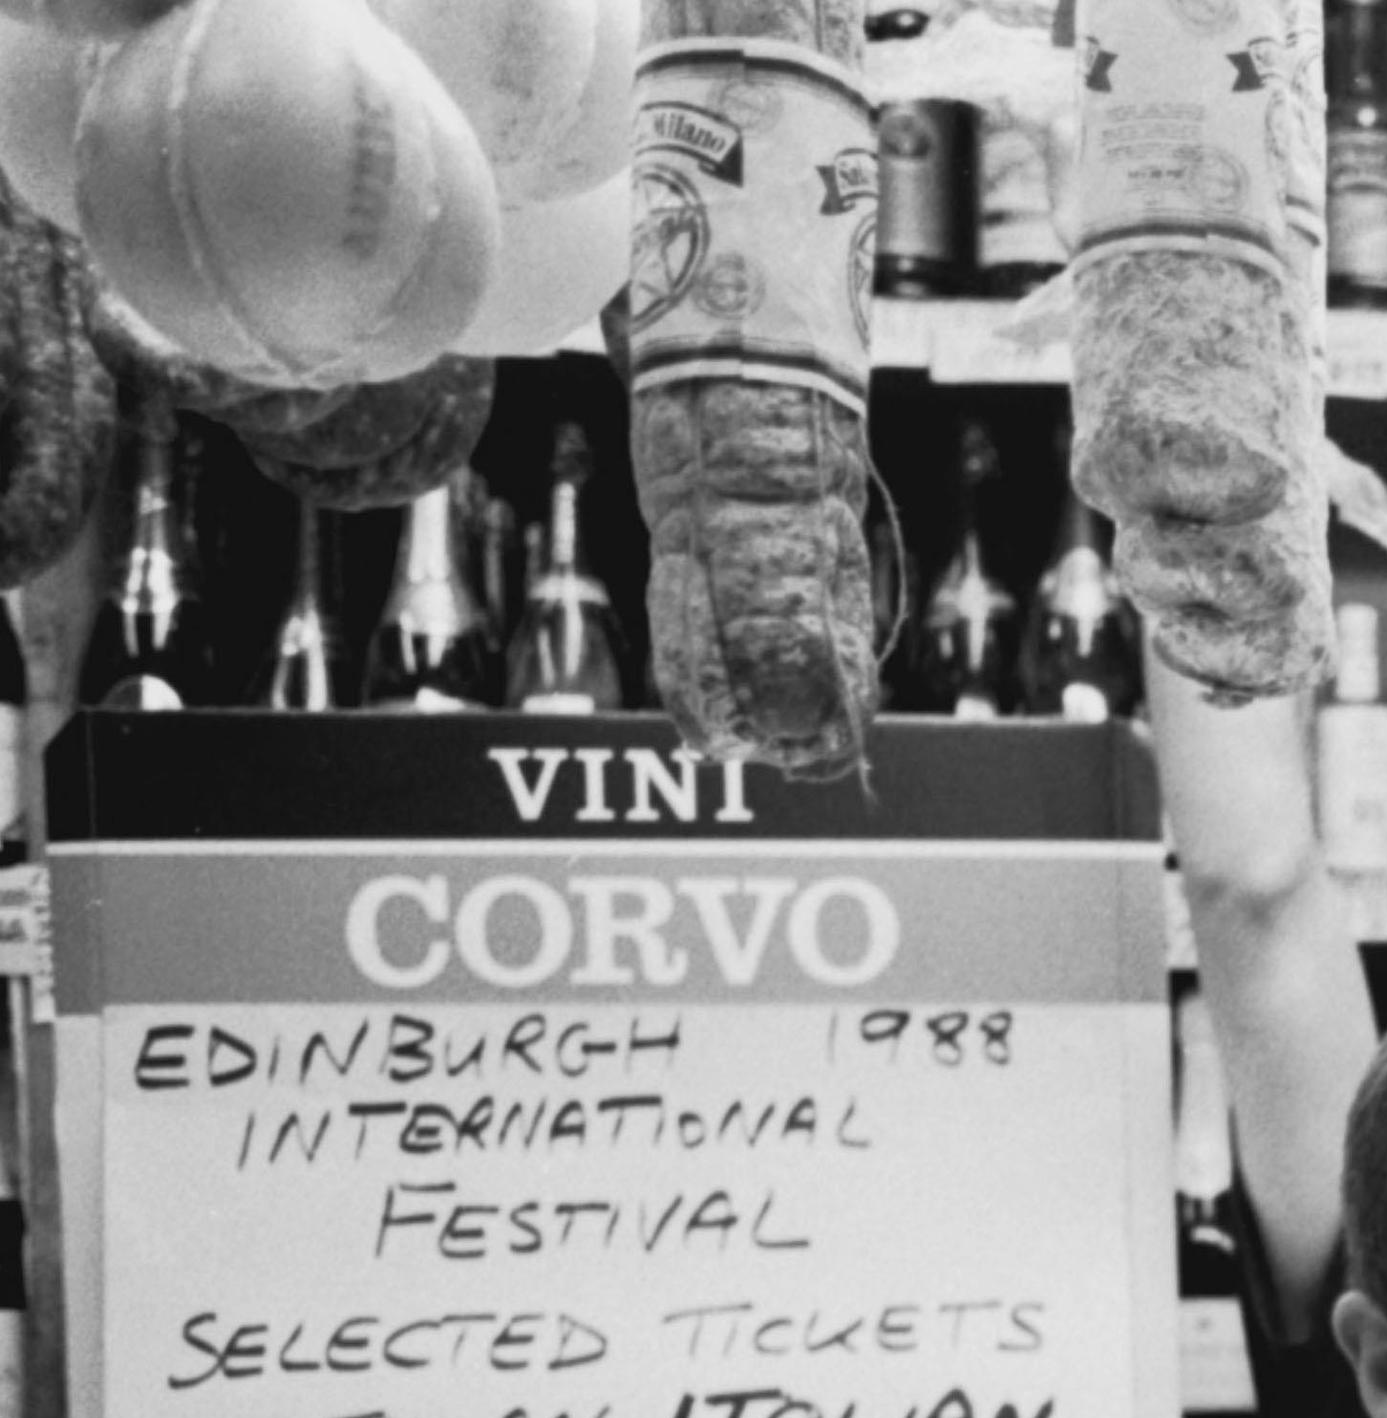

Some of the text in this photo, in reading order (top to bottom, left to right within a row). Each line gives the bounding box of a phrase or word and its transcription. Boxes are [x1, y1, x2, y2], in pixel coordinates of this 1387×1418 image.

[488, 748, 754, 823] VINI
[345, 875, 900, 988] CORVO
[131, 1008, 1016, 1090] EDINBURGH 1988
[236, 1093, 871, 1171] INTERNATIONAL
[373, 1181, 812, 1260] FESTIVAL
[165, 1300, 1047, 1390] SELECTED TICKETS
